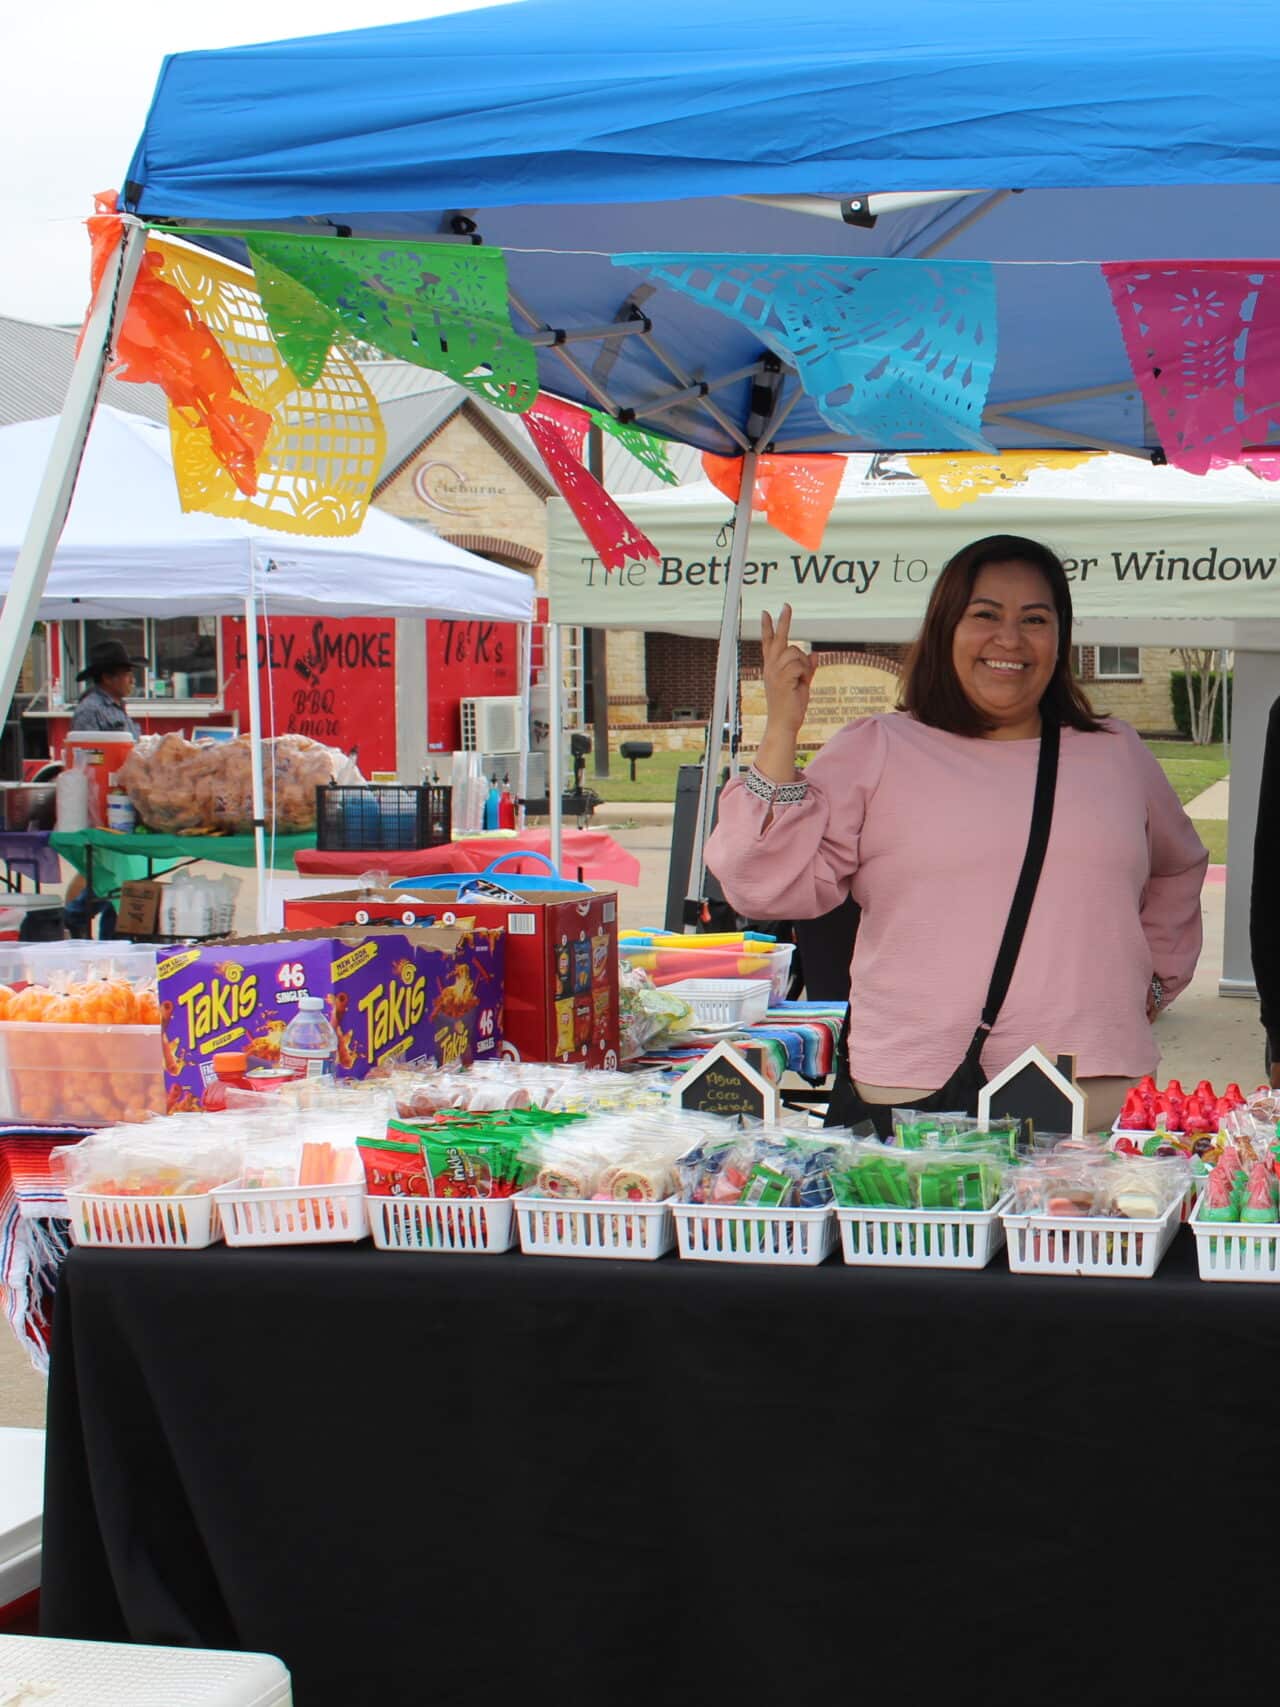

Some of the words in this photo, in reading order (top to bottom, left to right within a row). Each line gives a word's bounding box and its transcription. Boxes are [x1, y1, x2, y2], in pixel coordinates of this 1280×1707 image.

[658, 554, 778, 587] Better
[790, 554, 881, 594] Way
[893, 553, 929, 583] to
[311, 621, 392, 673] SMOKE
[292, 689, 335, 715] BBQ
[301, 719, 340, 737] more
[278, 963, 305, 987] 46
[275, 989, 310, 1004] SINGLES
[178, 973, 258, 1050] Takis
[358, 974, 426, 1064] Takis
[479, 1009, 494, 1036] 46
